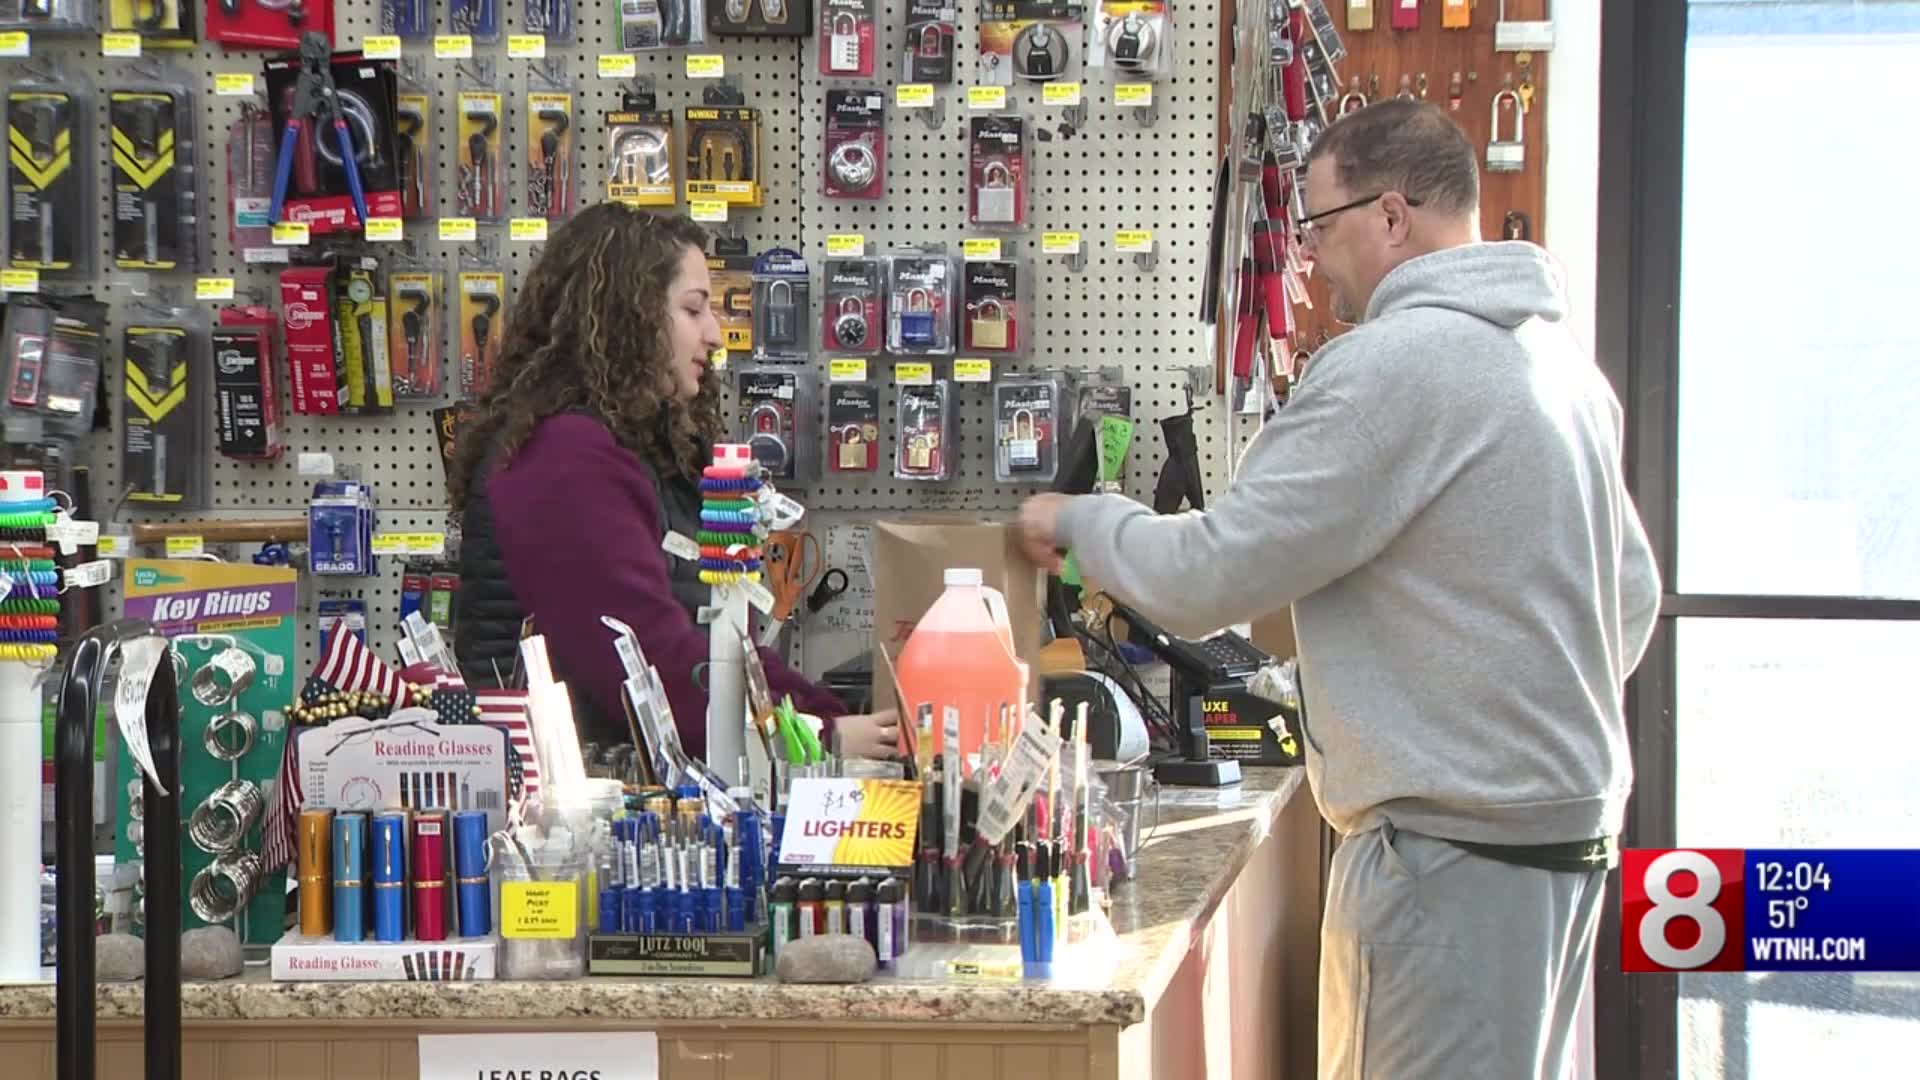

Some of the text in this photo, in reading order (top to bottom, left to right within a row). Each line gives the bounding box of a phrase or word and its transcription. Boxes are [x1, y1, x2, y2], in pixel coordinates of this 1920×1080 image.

[152, 590, 272, 622] Key Rings
[1203, 701, 1229, 712] UXE
[1206, 714, 1237, 723] APER
[375, 740, 492, 758] Reading Glasses
[803, 820, 906, 839] LIGHTERS
[640, 936, 709, 955] LUTZ TOOL
[289, 956, 380, 970] Reading Glasse
[478, 1070, 601, 1080] LEAF BAGS
